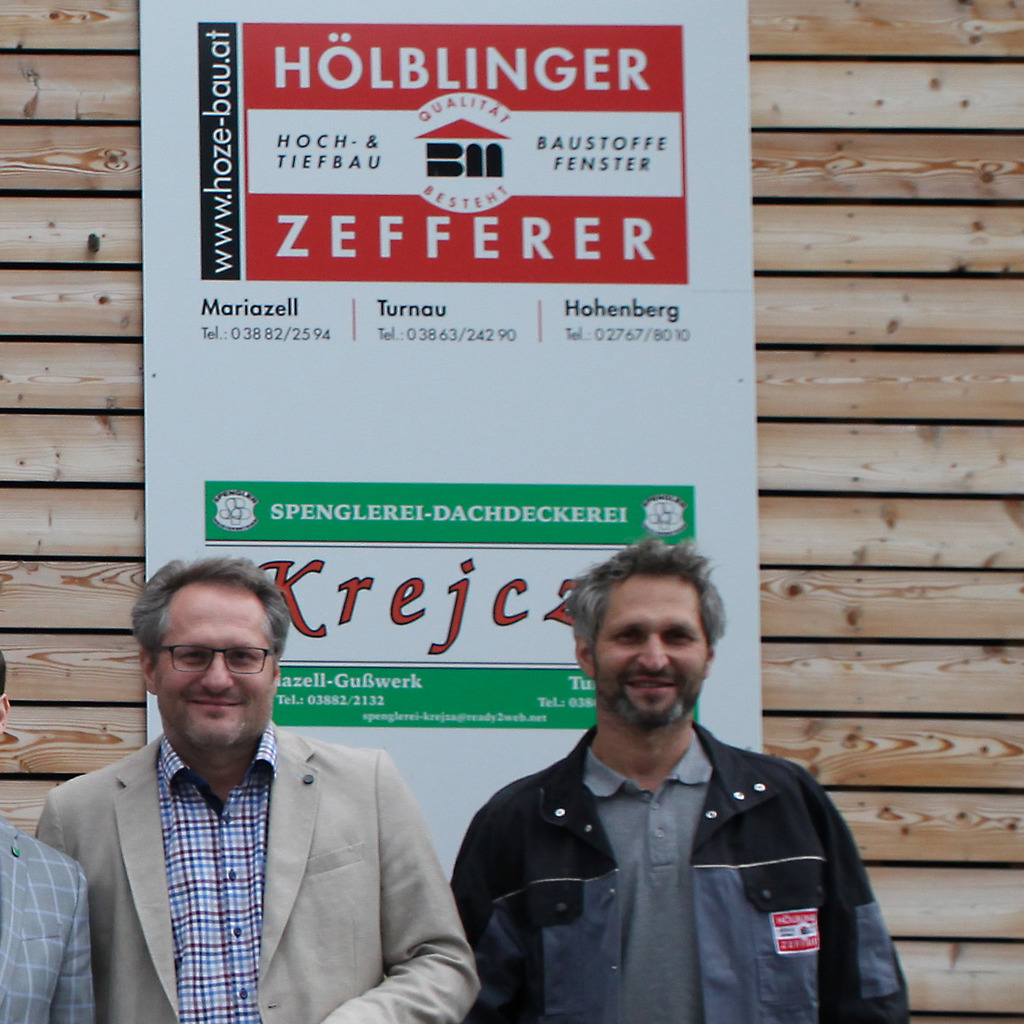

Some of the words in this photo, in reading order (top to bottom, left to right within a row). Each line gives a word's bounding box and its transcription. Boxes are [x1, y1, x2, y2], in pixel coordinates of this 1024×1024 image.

[275, 32, 651, 91] HÖLBLINGER
[277, 134, 357, 149] HOCH-
[366, 134, 378, 149] &
[537, 136, 667, 151] BAUSTOFFE
[202, 30, 233, 273] www.hoze-bau.at
[277, 154, 381, 170] TIEFBAU
[553, 156, 651, 171] FENSTER
[423, 185, 508, 209] BESTEHT
[277, 215, 655, 261] ZEFFERER
[201, 298, 298, 316] Mariazell
[377, 300, 447, 317] Turnau
[565, 299, 680, 323] Hohenberg
[270, 503, 628, 523] SPENGLEREI-DACHDECKEREI
[568, 676, 596, 690] Tu
[276, 694, 304, 705] Tel.:
[307, 695, 385, 707] 03882/2132
[537, 697, 566, 708] Tel.:
[568, 697, 596, 708] 038
